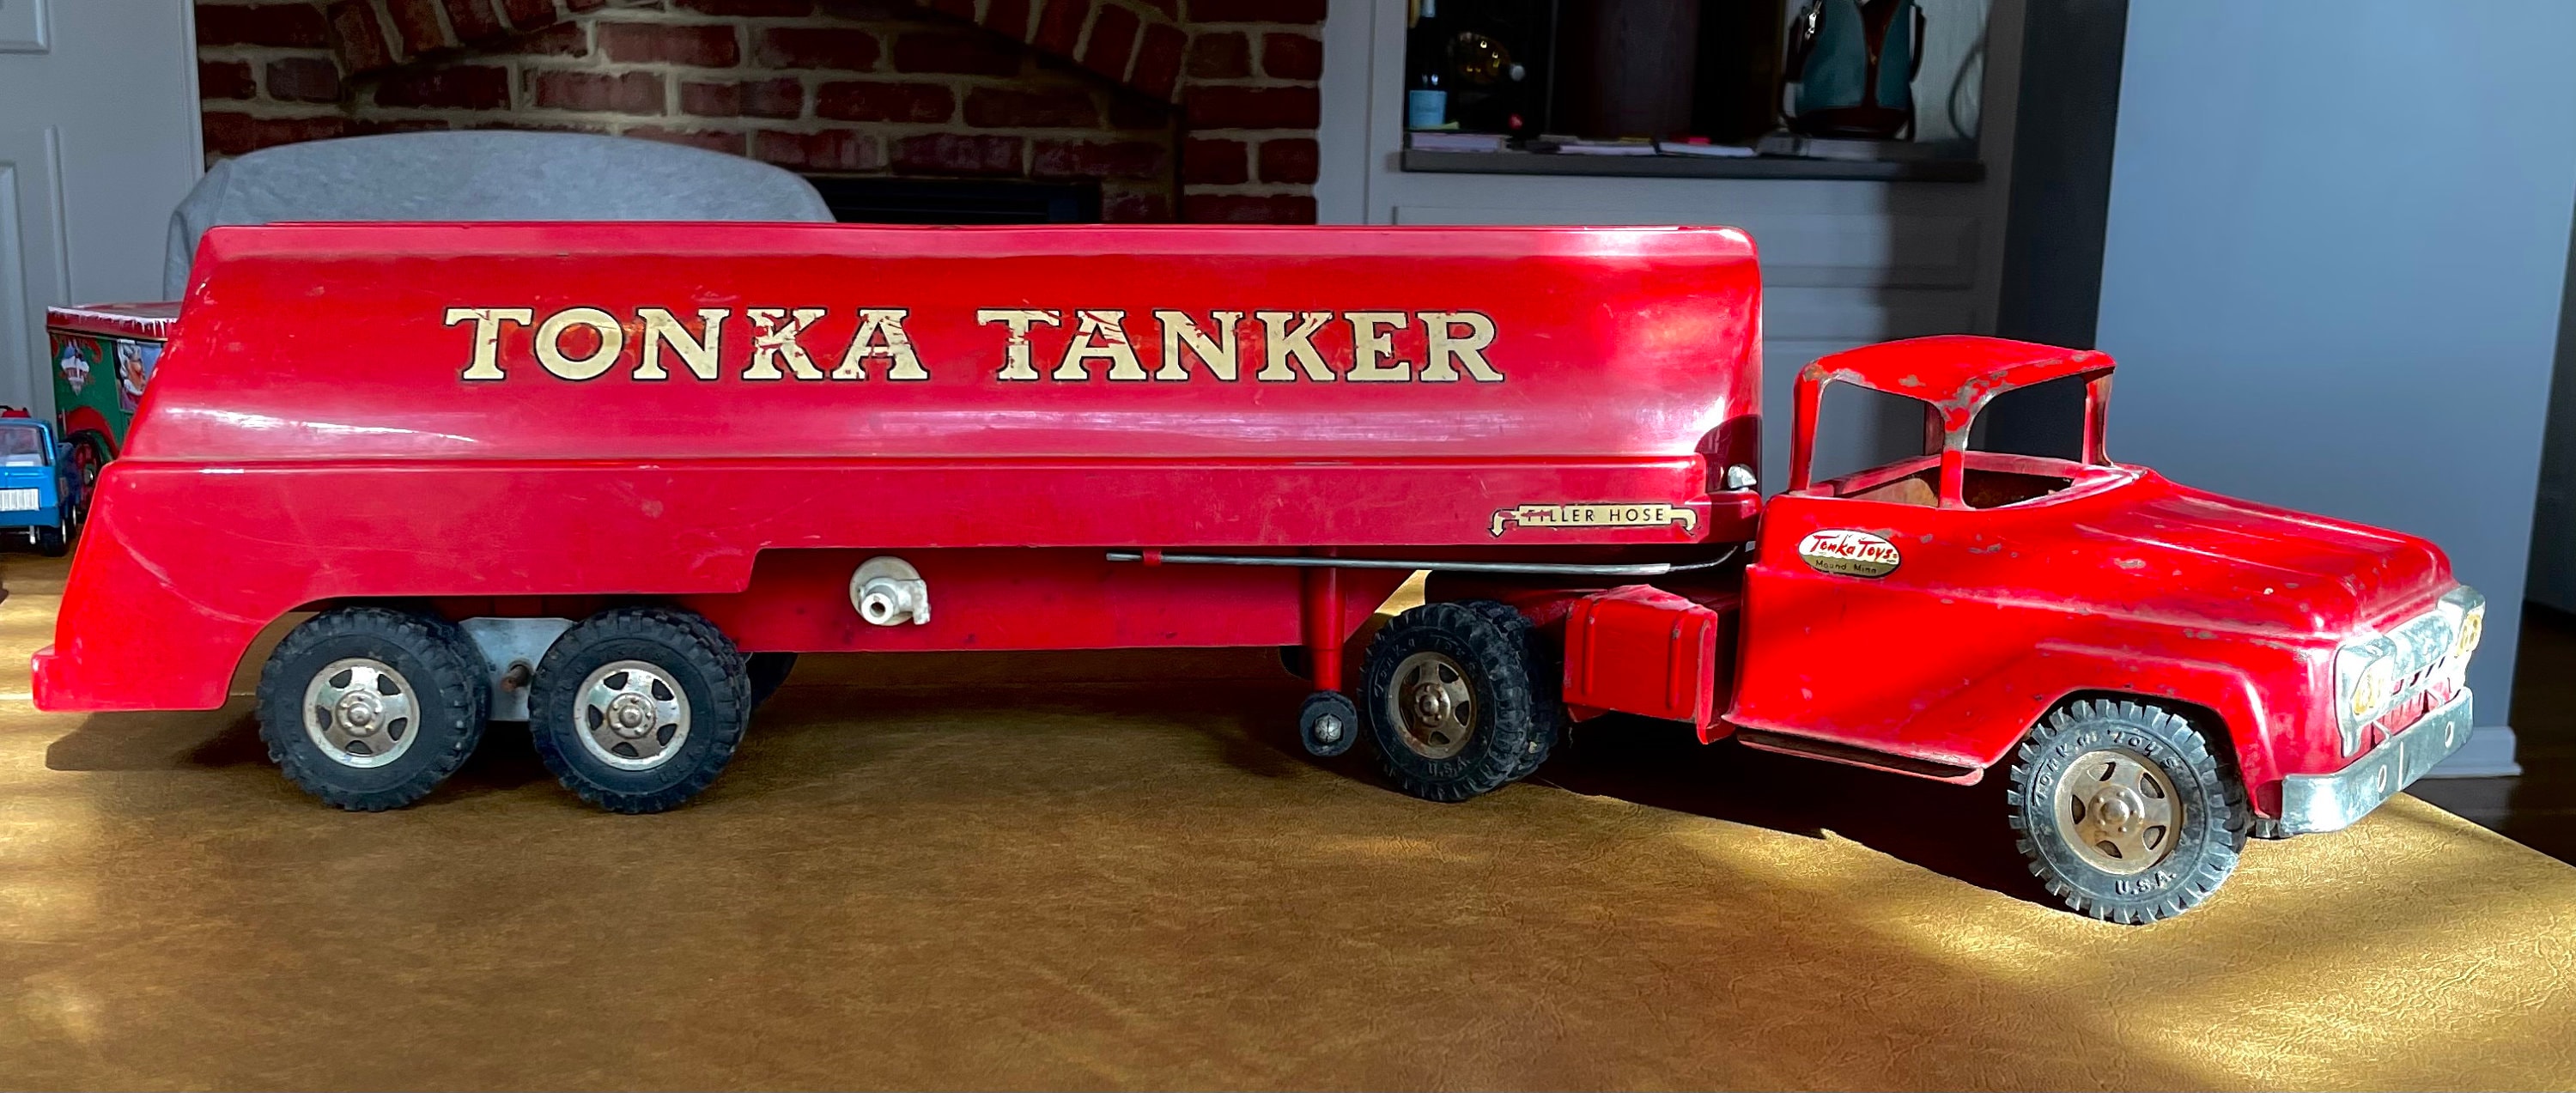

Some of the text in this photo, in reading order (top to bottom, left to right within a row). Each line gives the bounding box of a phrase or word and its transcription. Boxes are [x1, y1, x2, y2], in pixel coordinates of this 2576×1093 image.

[444, 307, 1505, 382] TONKA TANKER
[1609, 508, 1663, 522] HOSE
[1810, 533, 1856, 556] Tonka
[2115, 869, 2177, 895] U.S.A.
